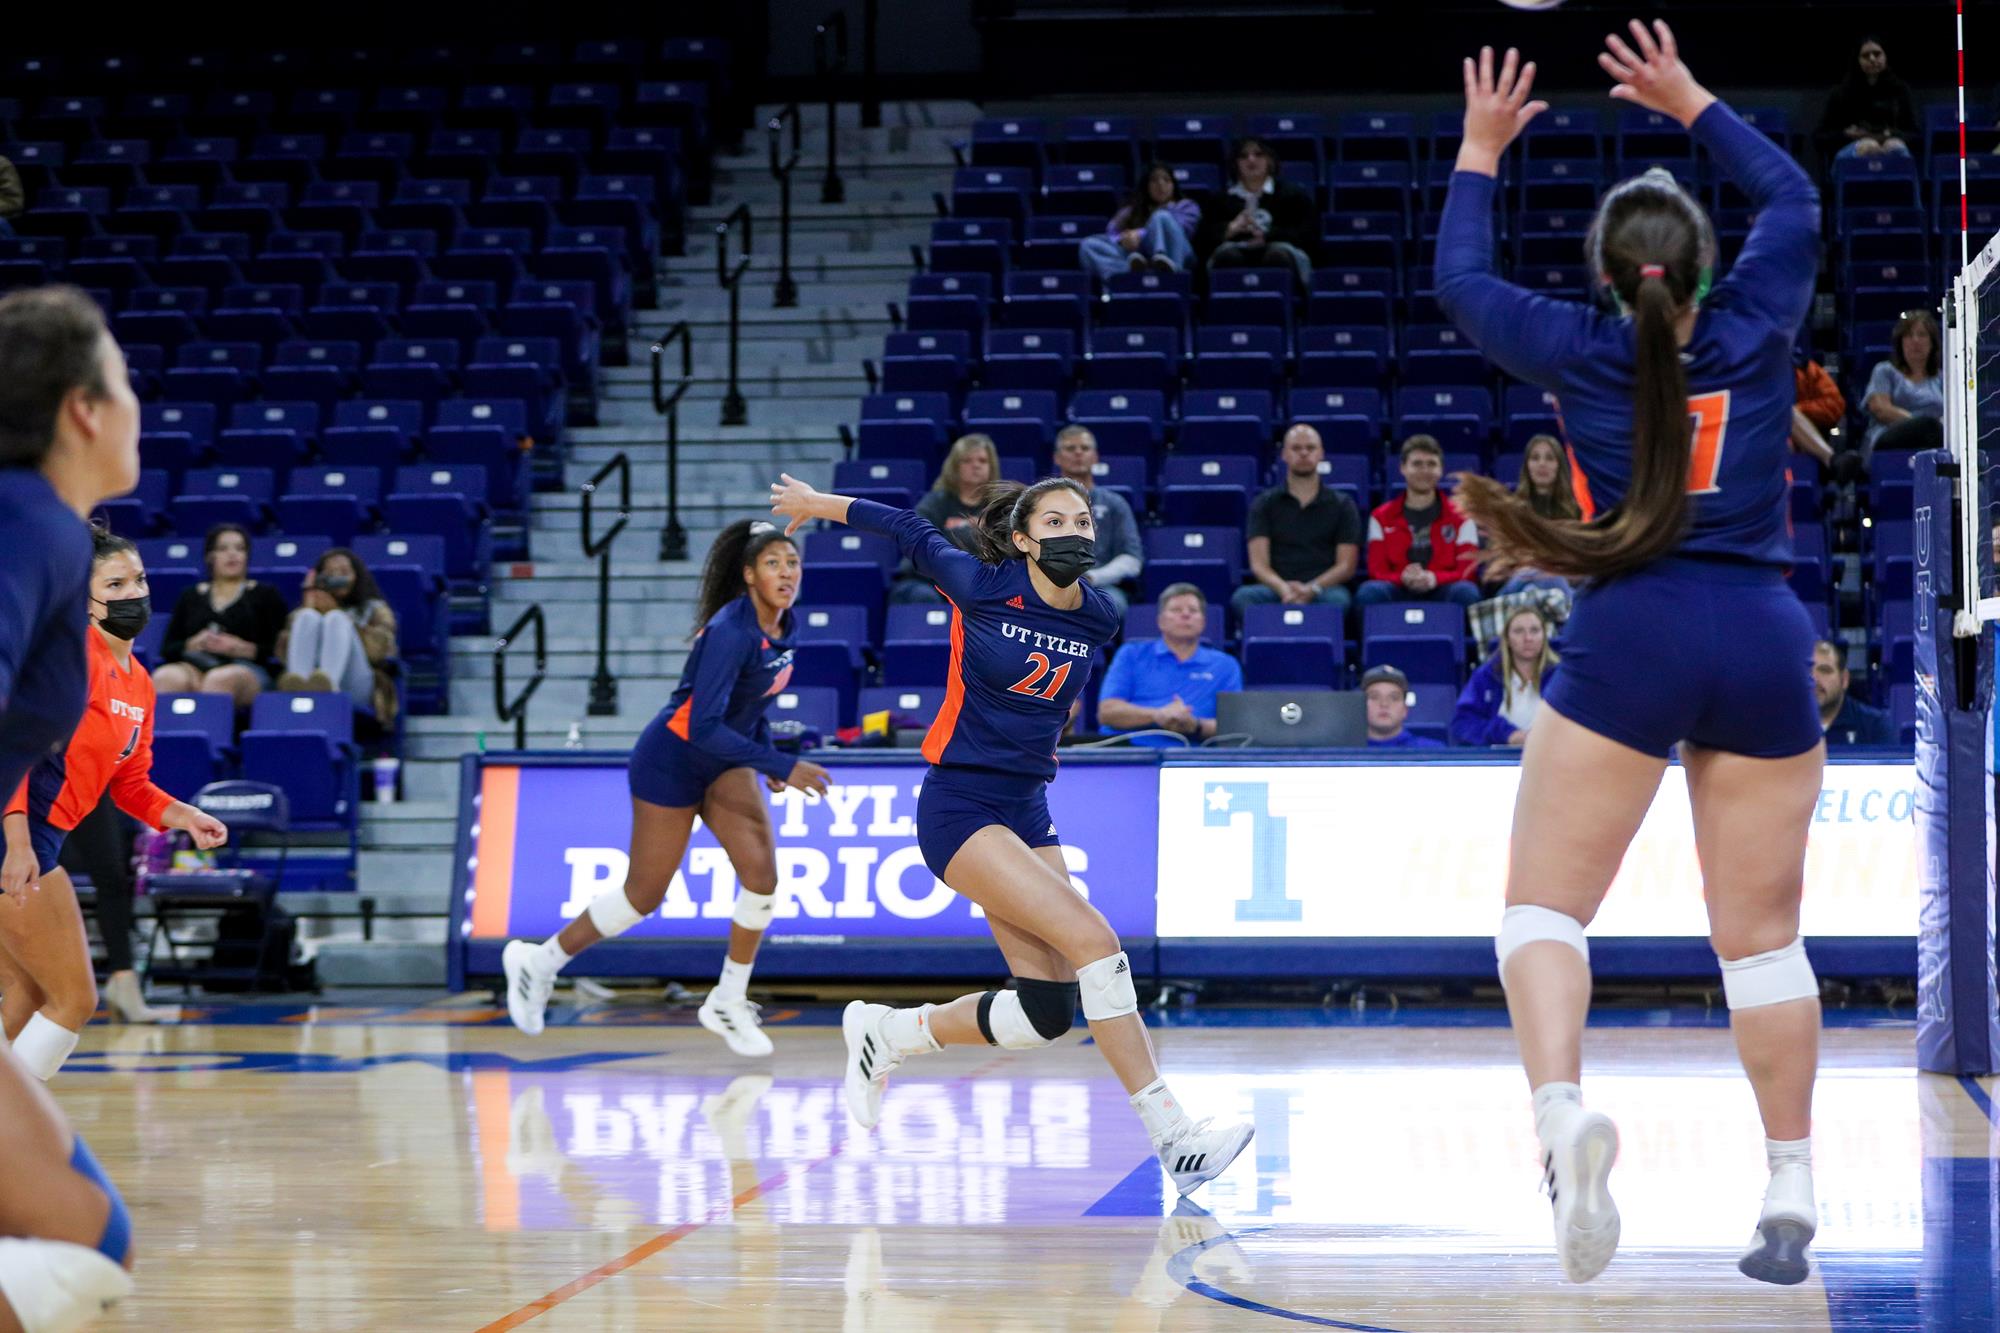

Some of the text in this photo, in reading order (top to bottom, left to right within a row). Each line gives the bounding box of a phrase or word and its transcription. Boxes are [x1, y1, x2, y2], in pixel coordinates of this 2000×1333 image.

[1915, 505, 1932, 631] UT
[1001, 622, 1089, 658] UT TYLER
[1006, 651, 1072, 702] 21
[770, 785, 920, 837] TYL
[1815, 788, 1914, 822] ELCO
[560, 846, 1090, 919] PTRIO
